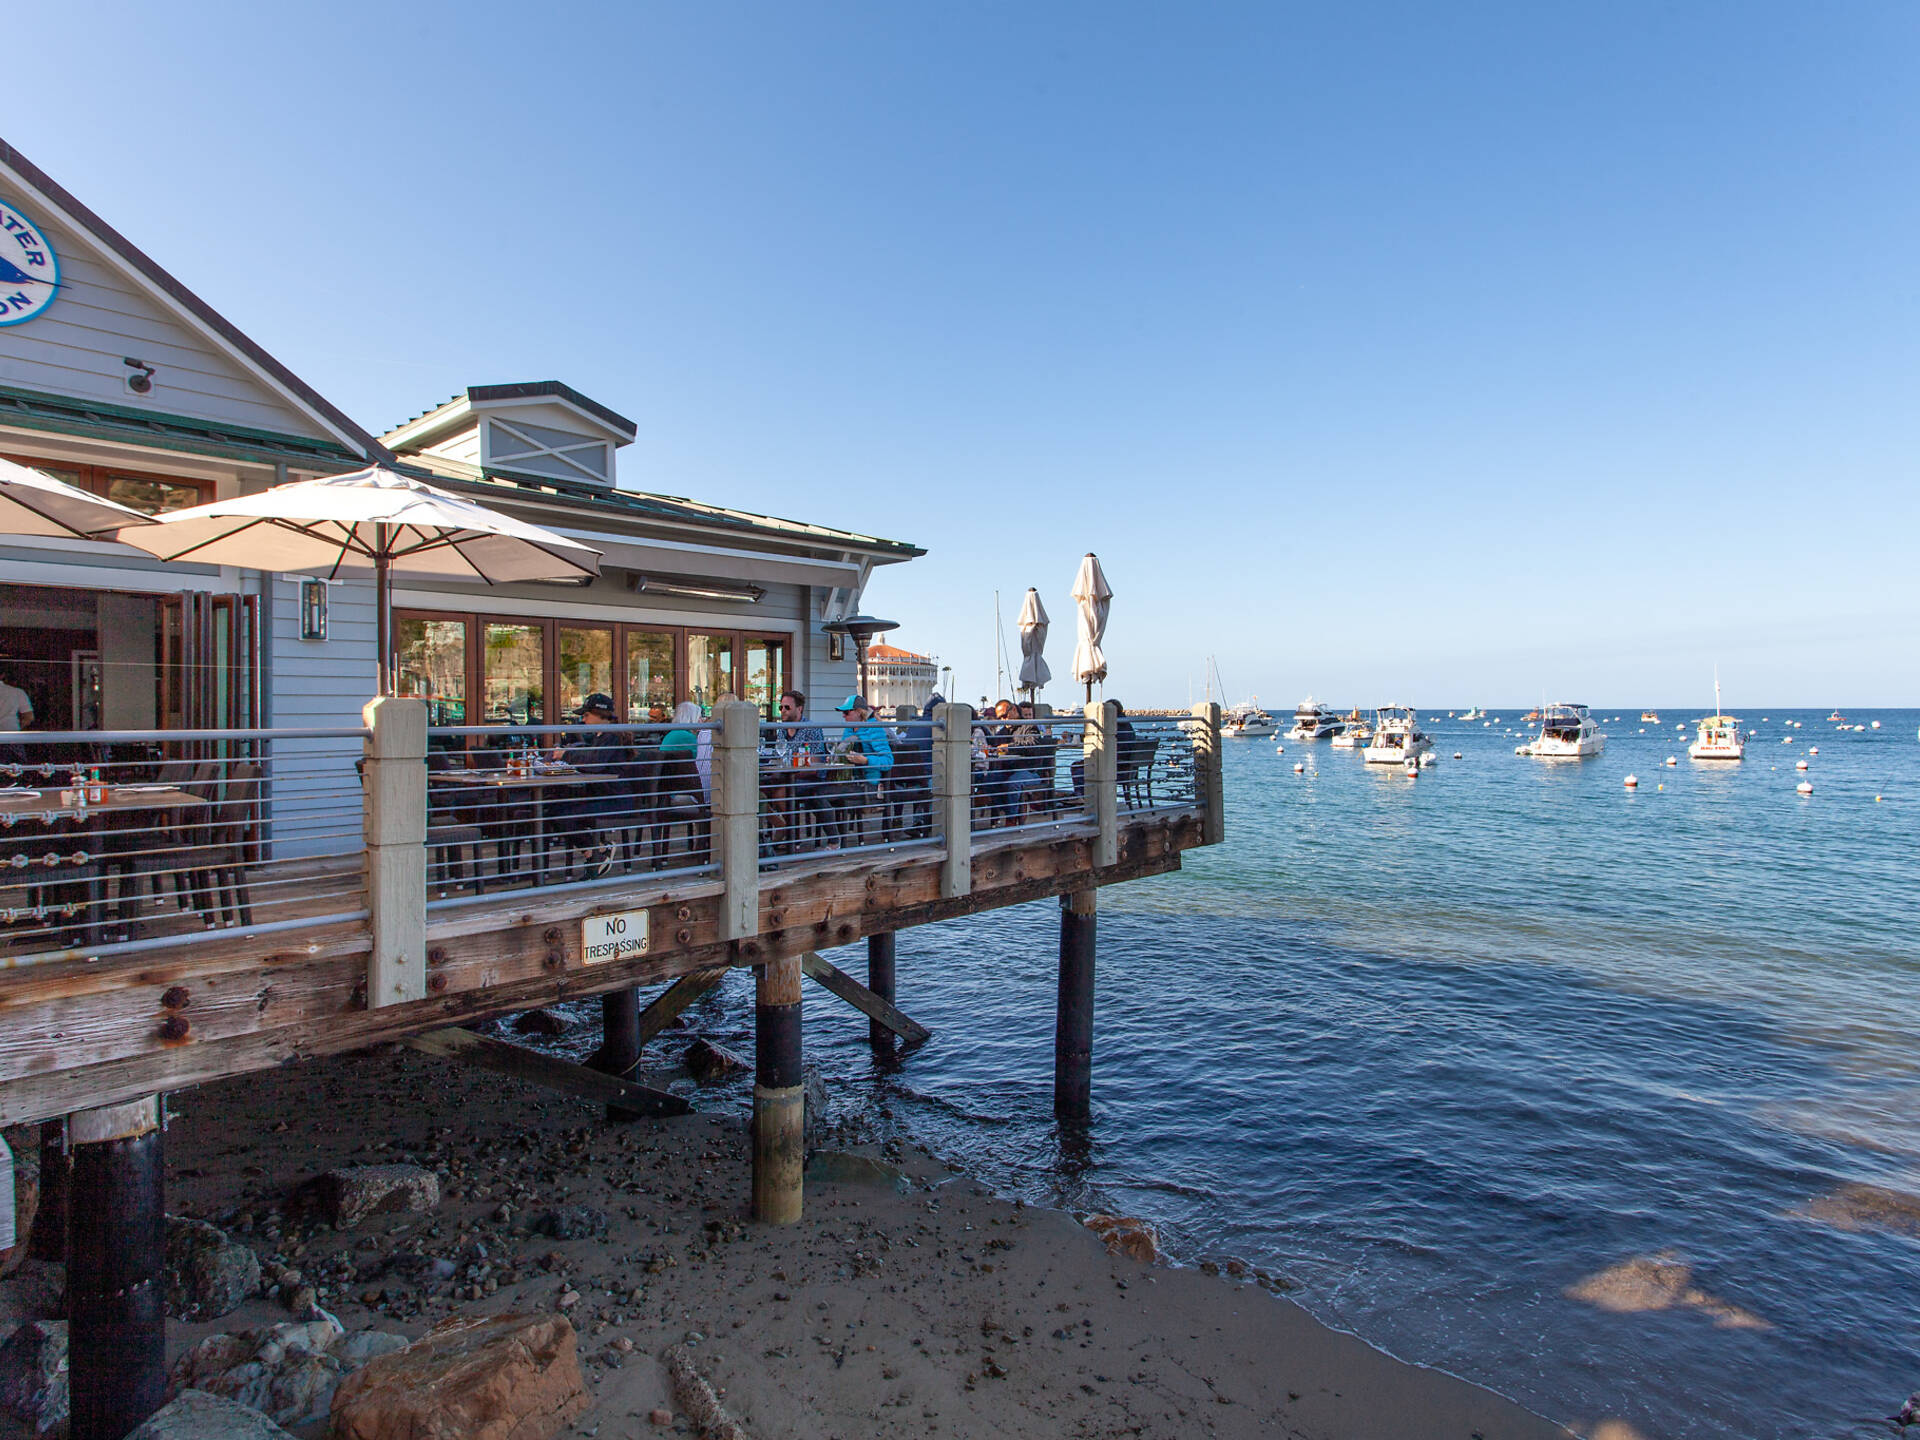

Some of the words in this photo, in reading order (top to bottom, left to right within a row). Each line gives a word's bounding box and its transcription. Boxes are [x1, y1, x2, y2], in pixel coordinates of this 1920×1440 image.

[0, 210, 46, 267] TER
[606, 918, 626, 936] NO
[585, 937, 647, 959] TRESPASSING
